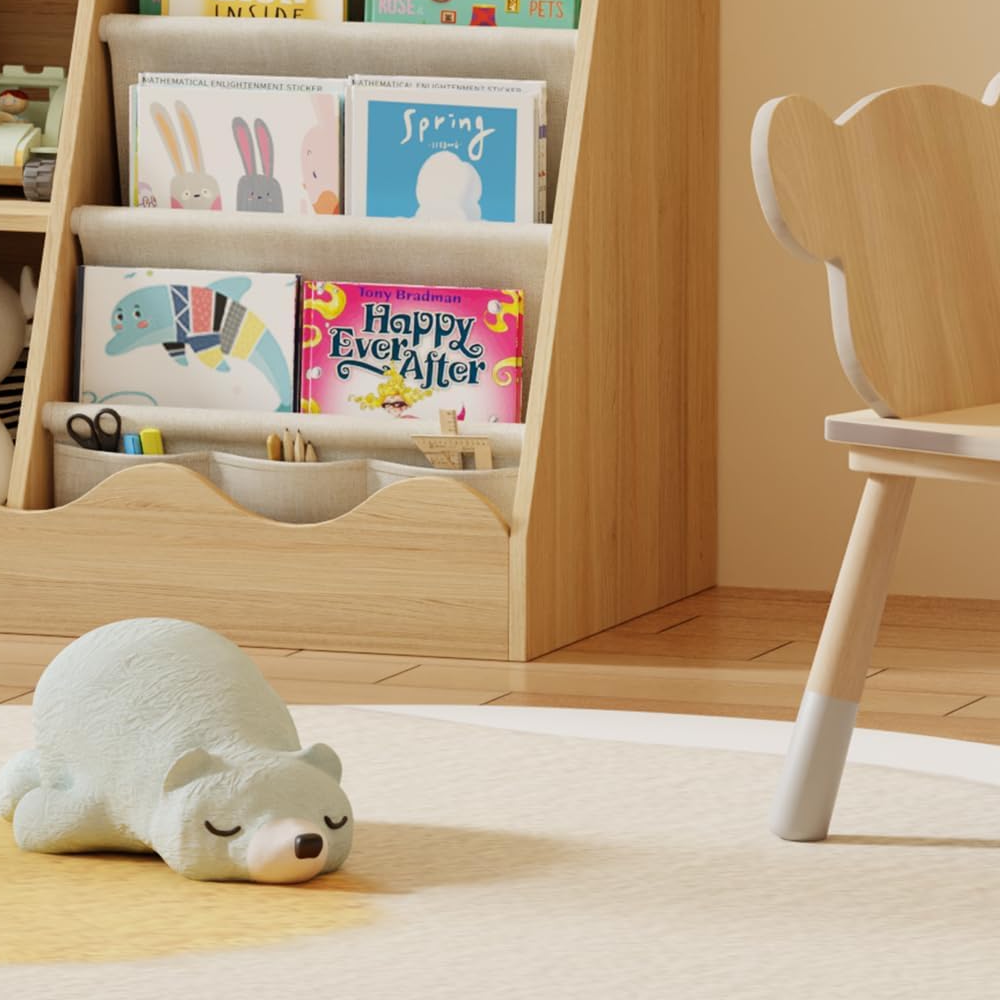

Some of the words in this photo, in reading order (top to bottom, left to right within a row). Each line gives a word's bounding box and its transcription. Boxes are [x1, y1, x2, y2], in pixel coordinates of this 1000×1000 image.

[528, 0, 565, 19] PETS
[400, 109, 495, 161] Spring
[359, 287, 392, 302] Tony
[396, 288, 461, 303] Bradman
[328, 327, 408, 361] Ever
[362, 302, 484, 358] Happy
[399, 349, 486, 389] After
